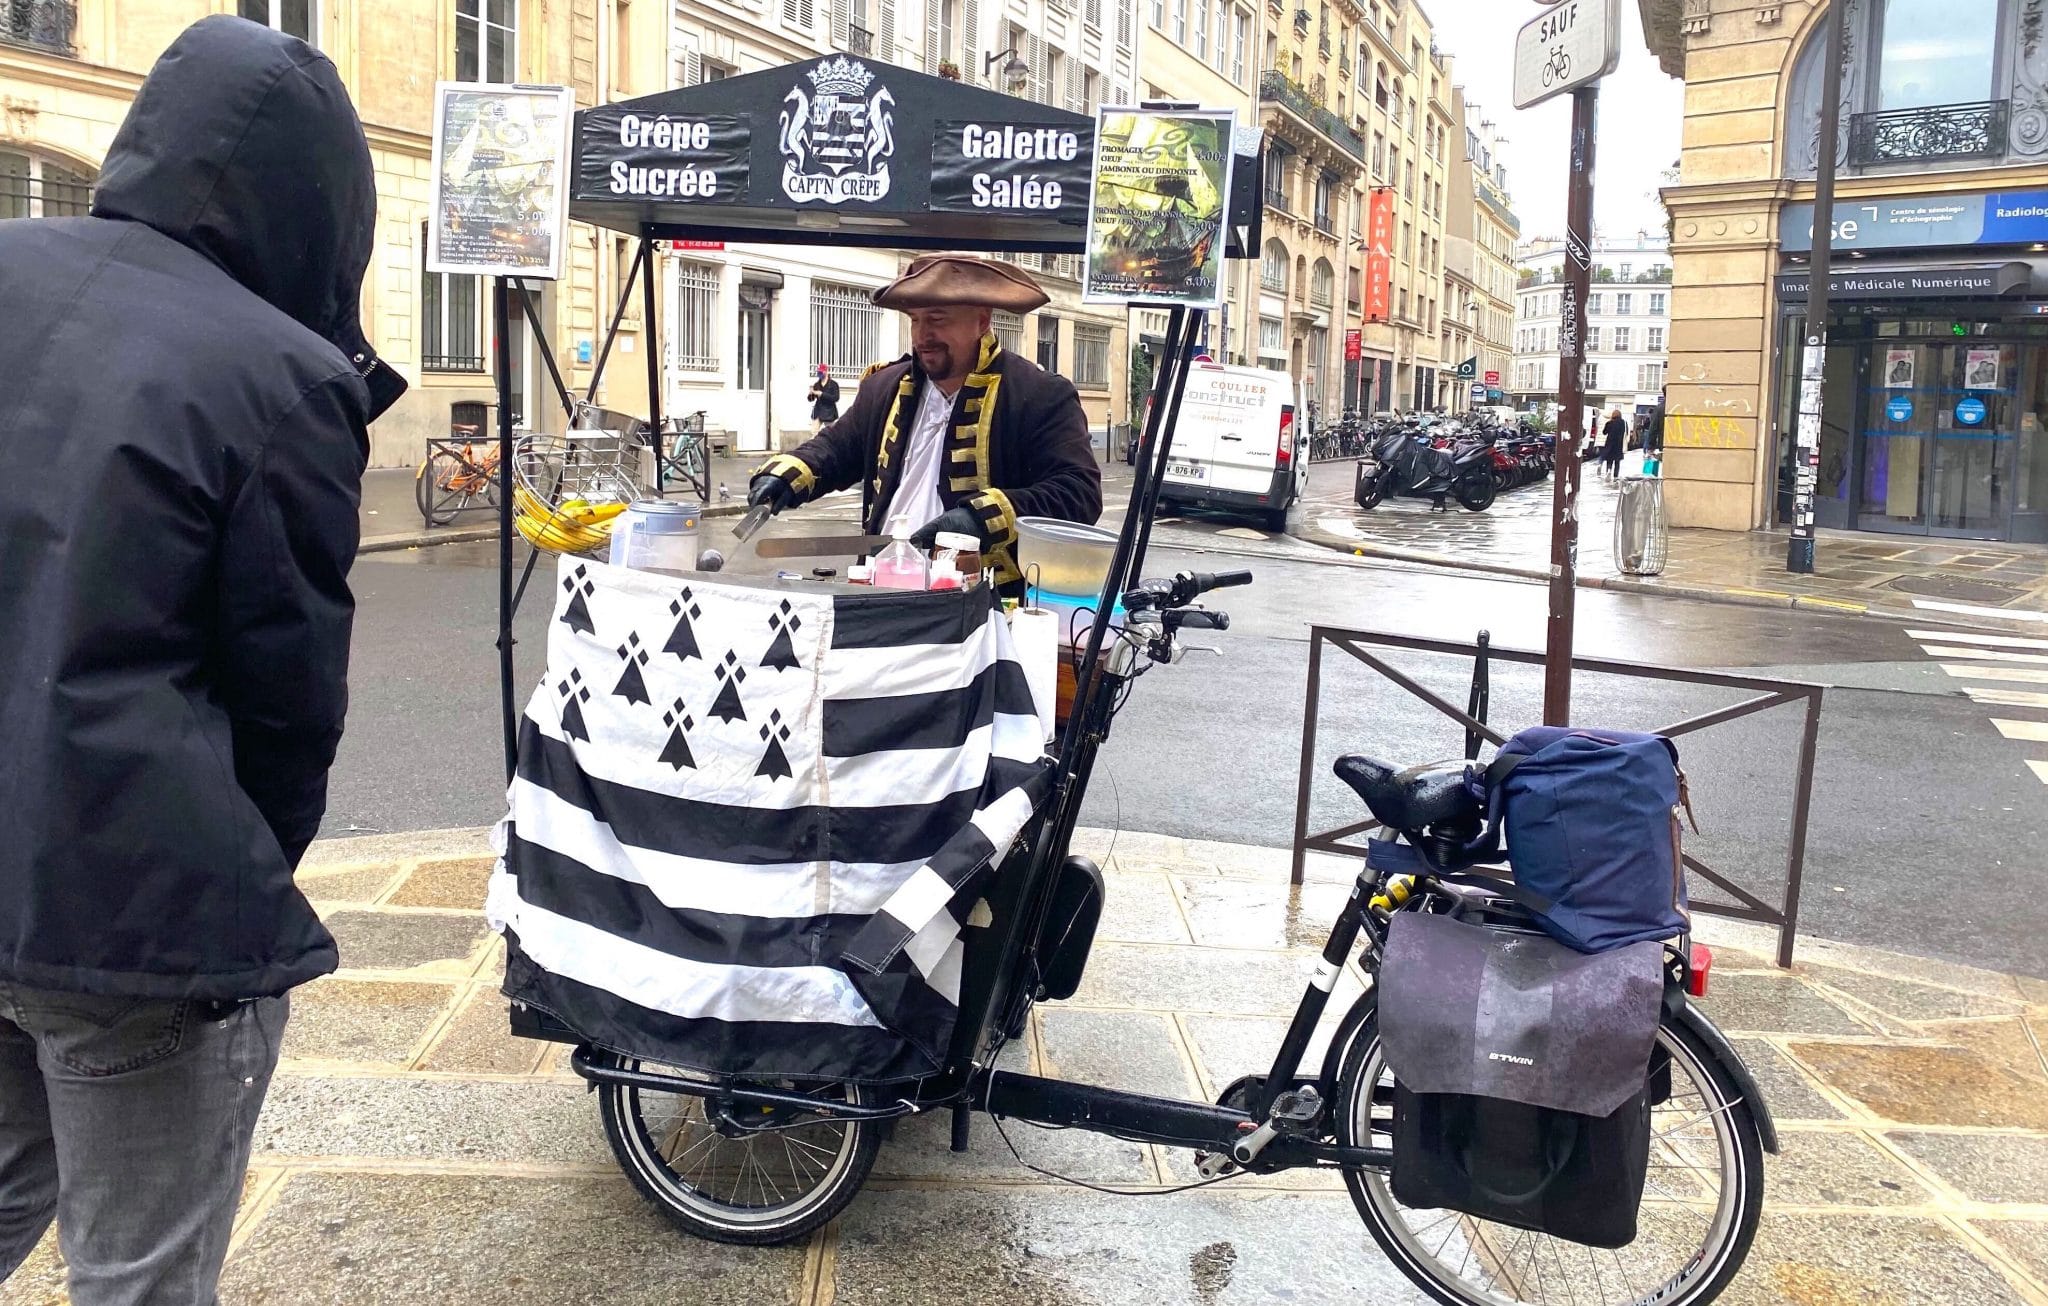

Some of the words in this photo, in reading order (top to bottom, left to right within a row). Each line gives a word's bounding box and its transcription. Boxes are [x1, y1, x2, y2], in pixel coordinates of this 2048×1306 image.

[1540, 3, 1577, 43] SAUF
[620, 114, 710, 152] Crêpe
[962, 123, 1078, 161] Galette
[610, 161, 717, 197] Sucrée
[788, 176, 834, 195] CAPT'N
[841, 175, 880, 196] CRÊPE
[1100, 165, 1140, 174] JAMBONIX
[1142, 166, 1155, 174] OU
[972, 173, 1062, 209] Salée
[1782, 282, 1838, 292] Imae
[1844, 278, 1905, 290] Médicale
[1912, 276, 1991, 289] Numérique
[1211, 381, 1267, 394] COULIER
